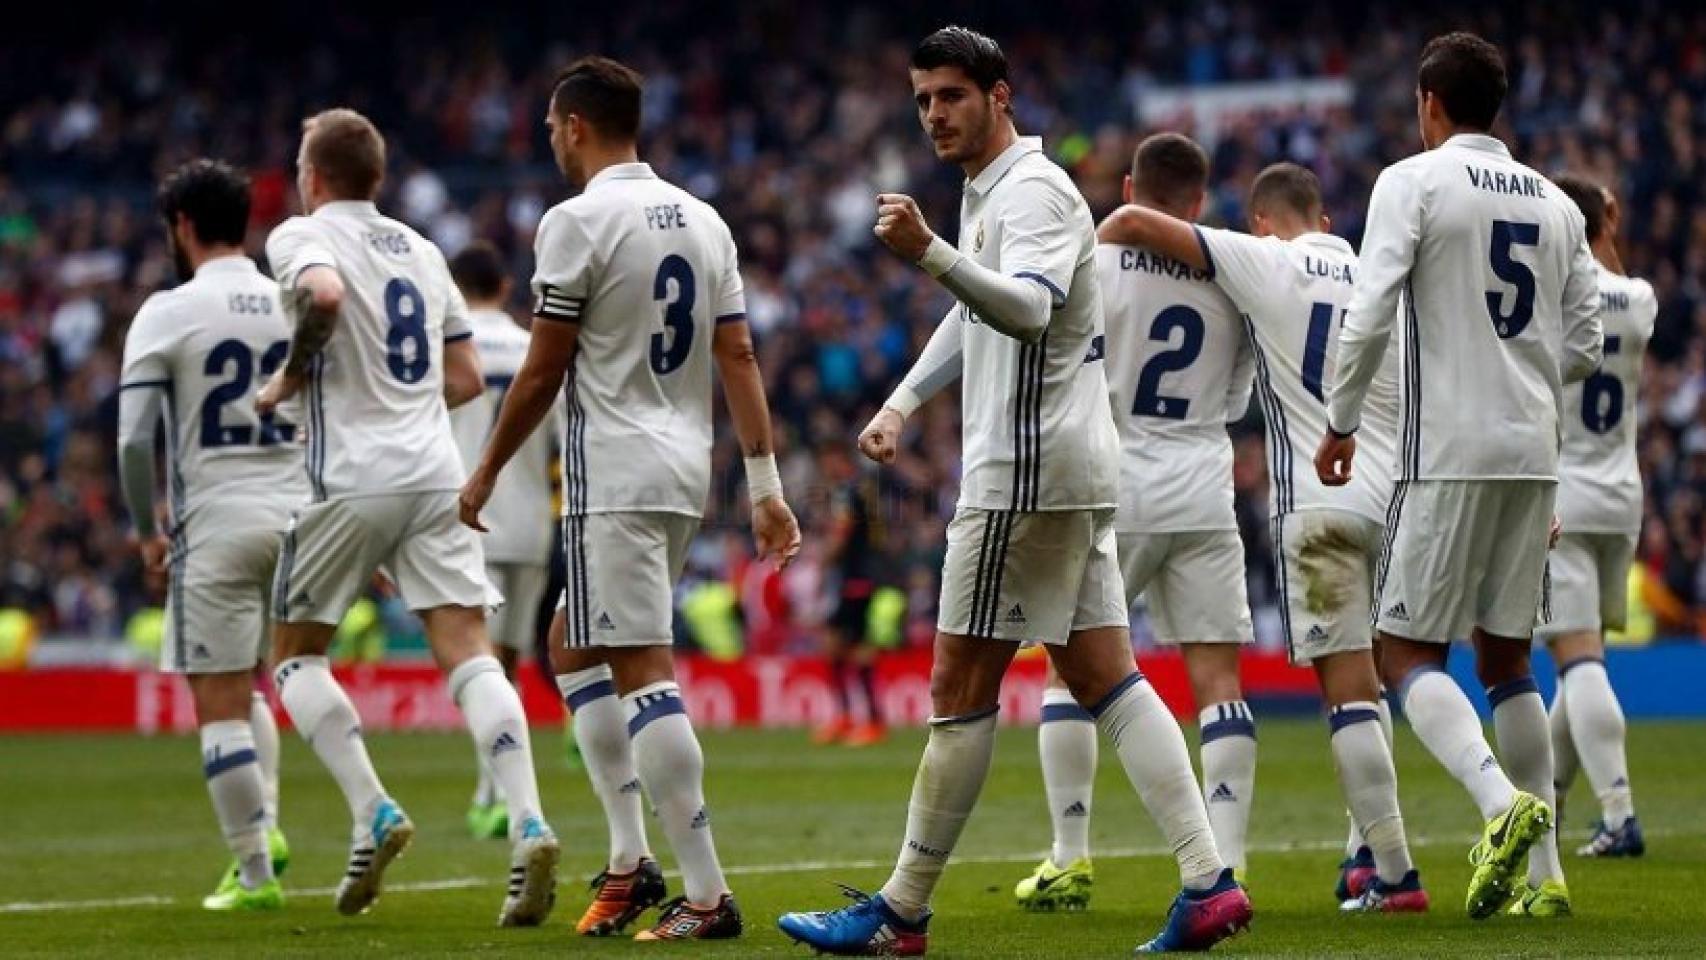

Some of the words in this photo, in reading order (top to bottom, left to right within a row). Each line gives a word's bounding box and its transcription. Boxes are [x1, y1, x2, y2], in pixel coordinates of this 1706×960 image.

[645, 204, 686, 229] PEPE
[1466, 165, 1546, 198] VARANE
[228, 294, 272, 314] ISCO
[650, 254, 695, 375] 3
[1305, 256, 1354, 284] LUCA
[1485, 219, 1540, 339] 5
[384, 277, 430, 384] 8
[1132, 304, 1205, 420] 2
[1582, 335, 1623, 434] 6
